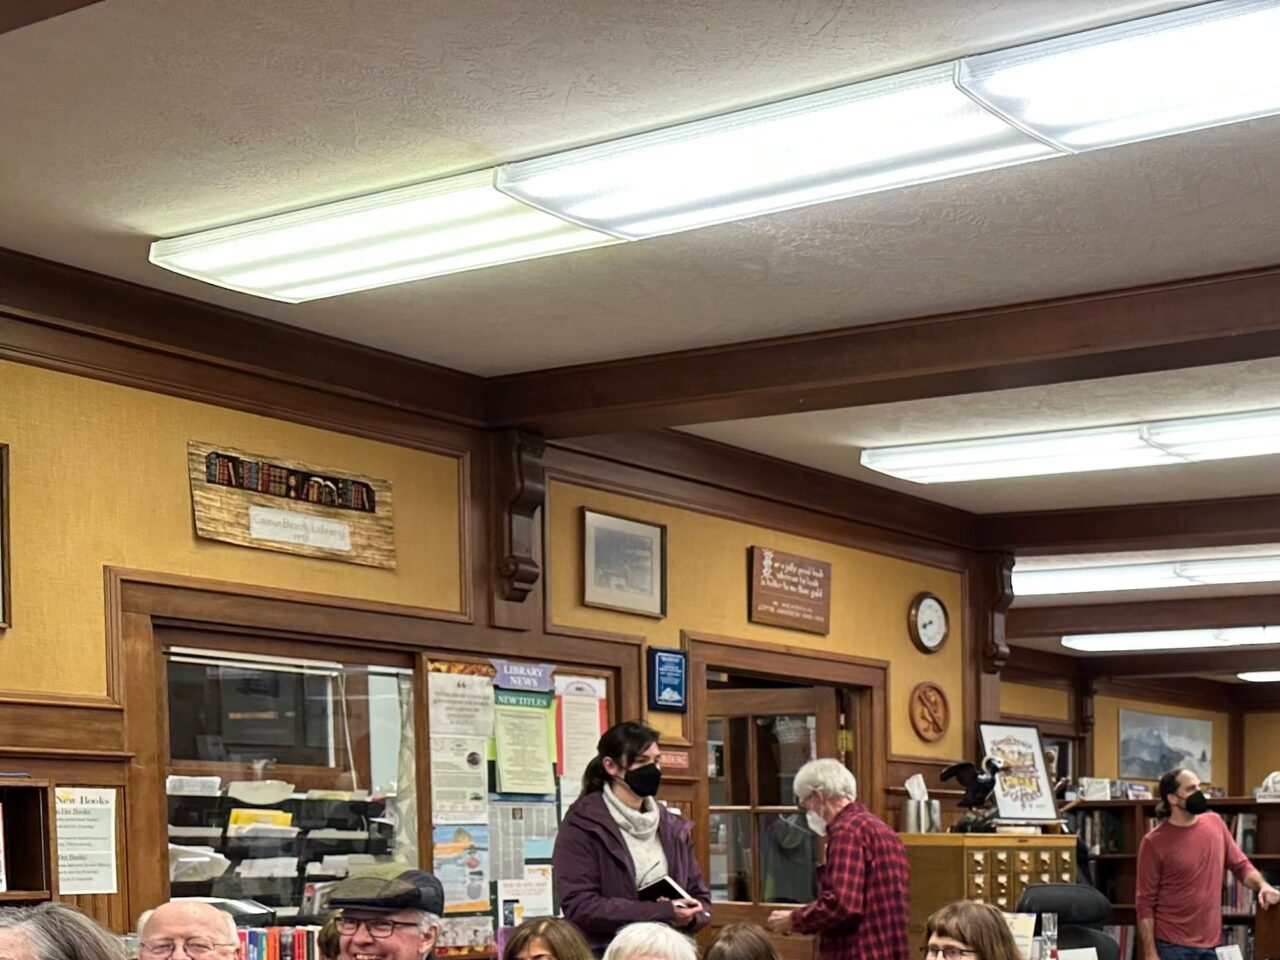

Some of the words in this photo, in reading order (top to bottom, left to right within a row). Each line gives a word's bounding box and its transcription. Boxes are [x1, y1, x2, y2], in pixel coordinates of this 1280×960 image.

[503, 664, 543, 677] LIBRARY
[510, 675, 538, 687] NEWS
[497, 695, 517, 705] NEW
[518, 697, 547, 706] TITLES
[80, 795, 110, 805] Books
